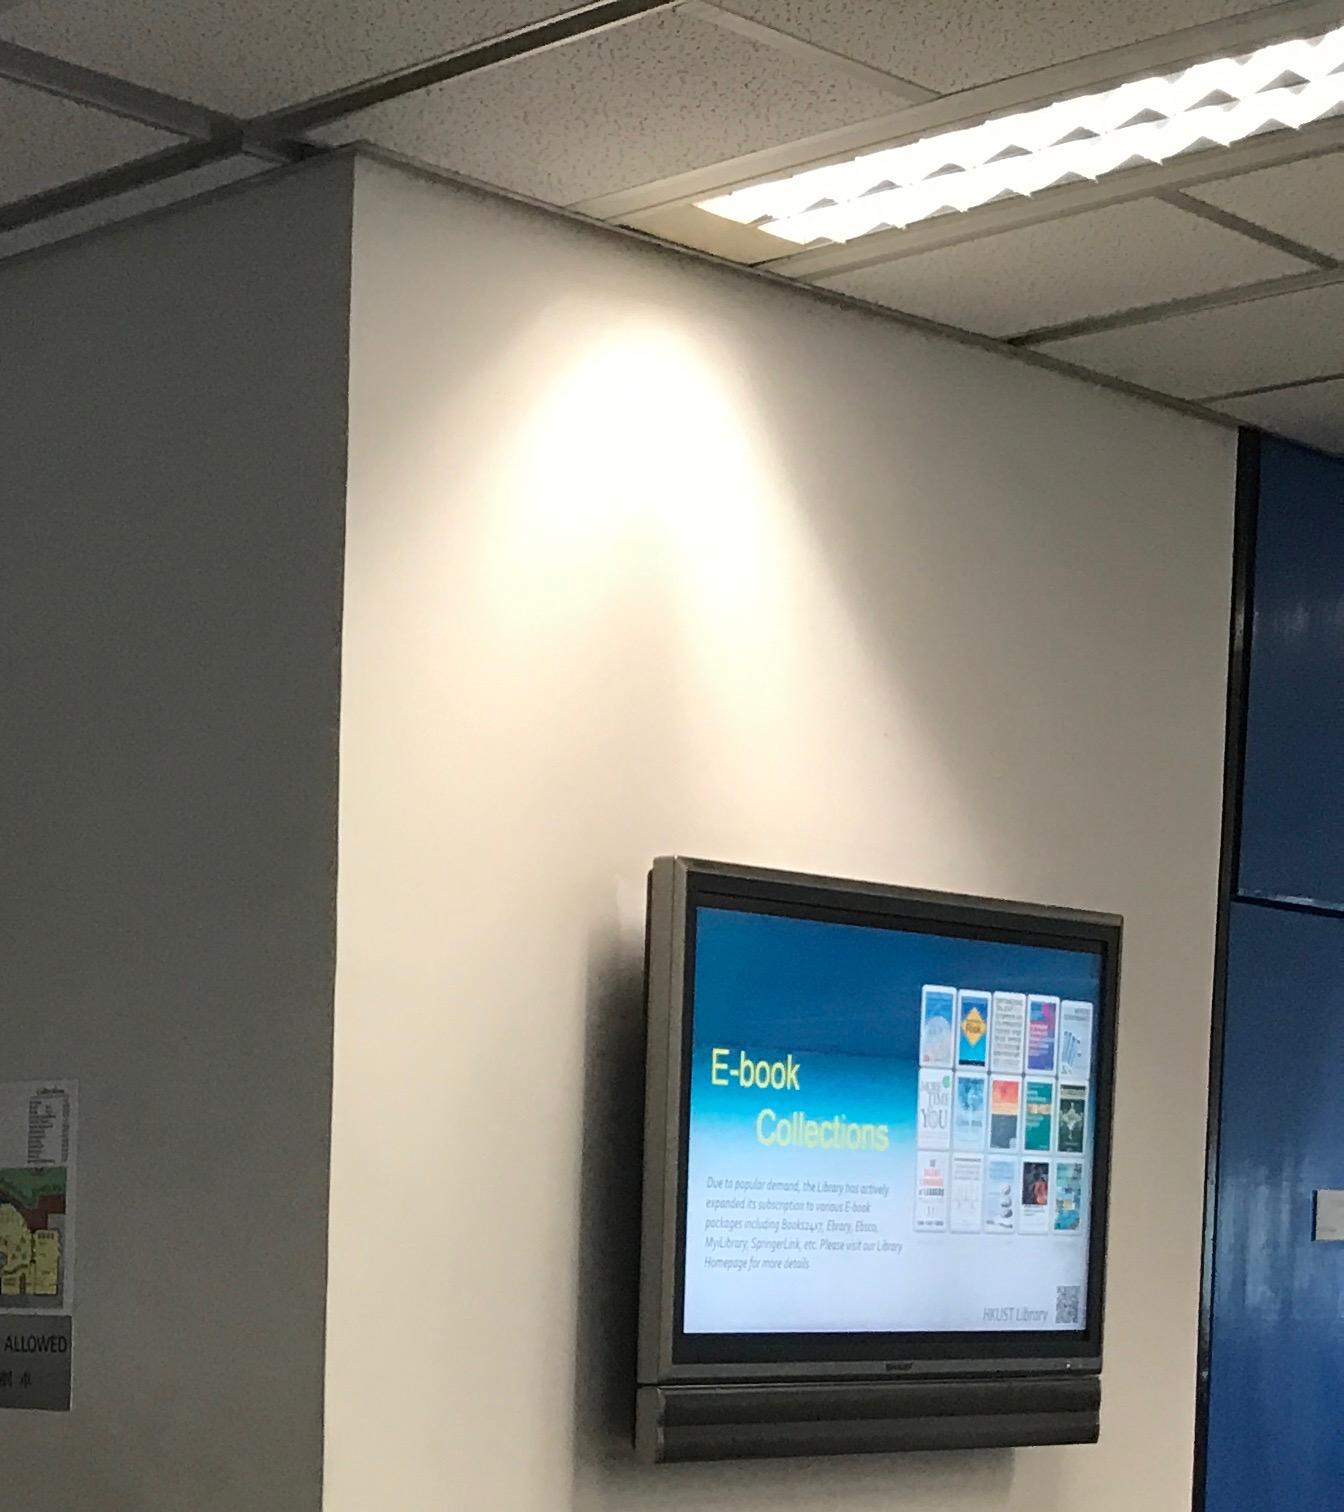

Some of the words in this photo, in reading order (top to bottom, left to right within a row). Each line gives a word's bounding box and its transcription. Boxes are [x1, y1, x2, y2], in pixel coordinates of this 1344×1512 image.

[712, 1047, 800, 1090] E-book
[921, 1108, 948, 1129] YOU
[756, 1108, 889, 1151] Collections
[706, 1176, 723, 1189] Due
[725, 1178, 733, 1189] to
[734, 1178, 765, 1192] popular
[767, 1178, 800, 1194] demand,
[803, 1180, 816, 1192] the
[817, 1181, 844, 1196] Library
[845, 1183, 859, 1194] has
[860, 1183, 889, 1198] actively
[706, 1197, 744, 1211] expanded
[747, 1198, 756, 1210] its
[758, 1199, 804, 1213] subscription
[806, 1200, 814, 1211] to
[816, 1202, 843, 1211] various
[844, 1201, 871, 1213] E-book
[705, 1218, 742, 1231] packages
[744, 1219, 780, 1233] including
[819, 1239, 845, 1251] Please
[846, 1240, 862, 1251] visit
[863, 1242, 875, 1251] our
[877, 1240, 903, 1254] Library
[704, 1256, 747, 1271] Homepage
[747, 1256, 761, 1272] for
[762, 1259, 782, 1269] more
[783, 1257, 809, 1269] details
[983, 1307, 1014, 1321] HKUST
[1016, 1307, 1048, 1322] Library
[4, 1335, 67, 1353] ALLOWED
